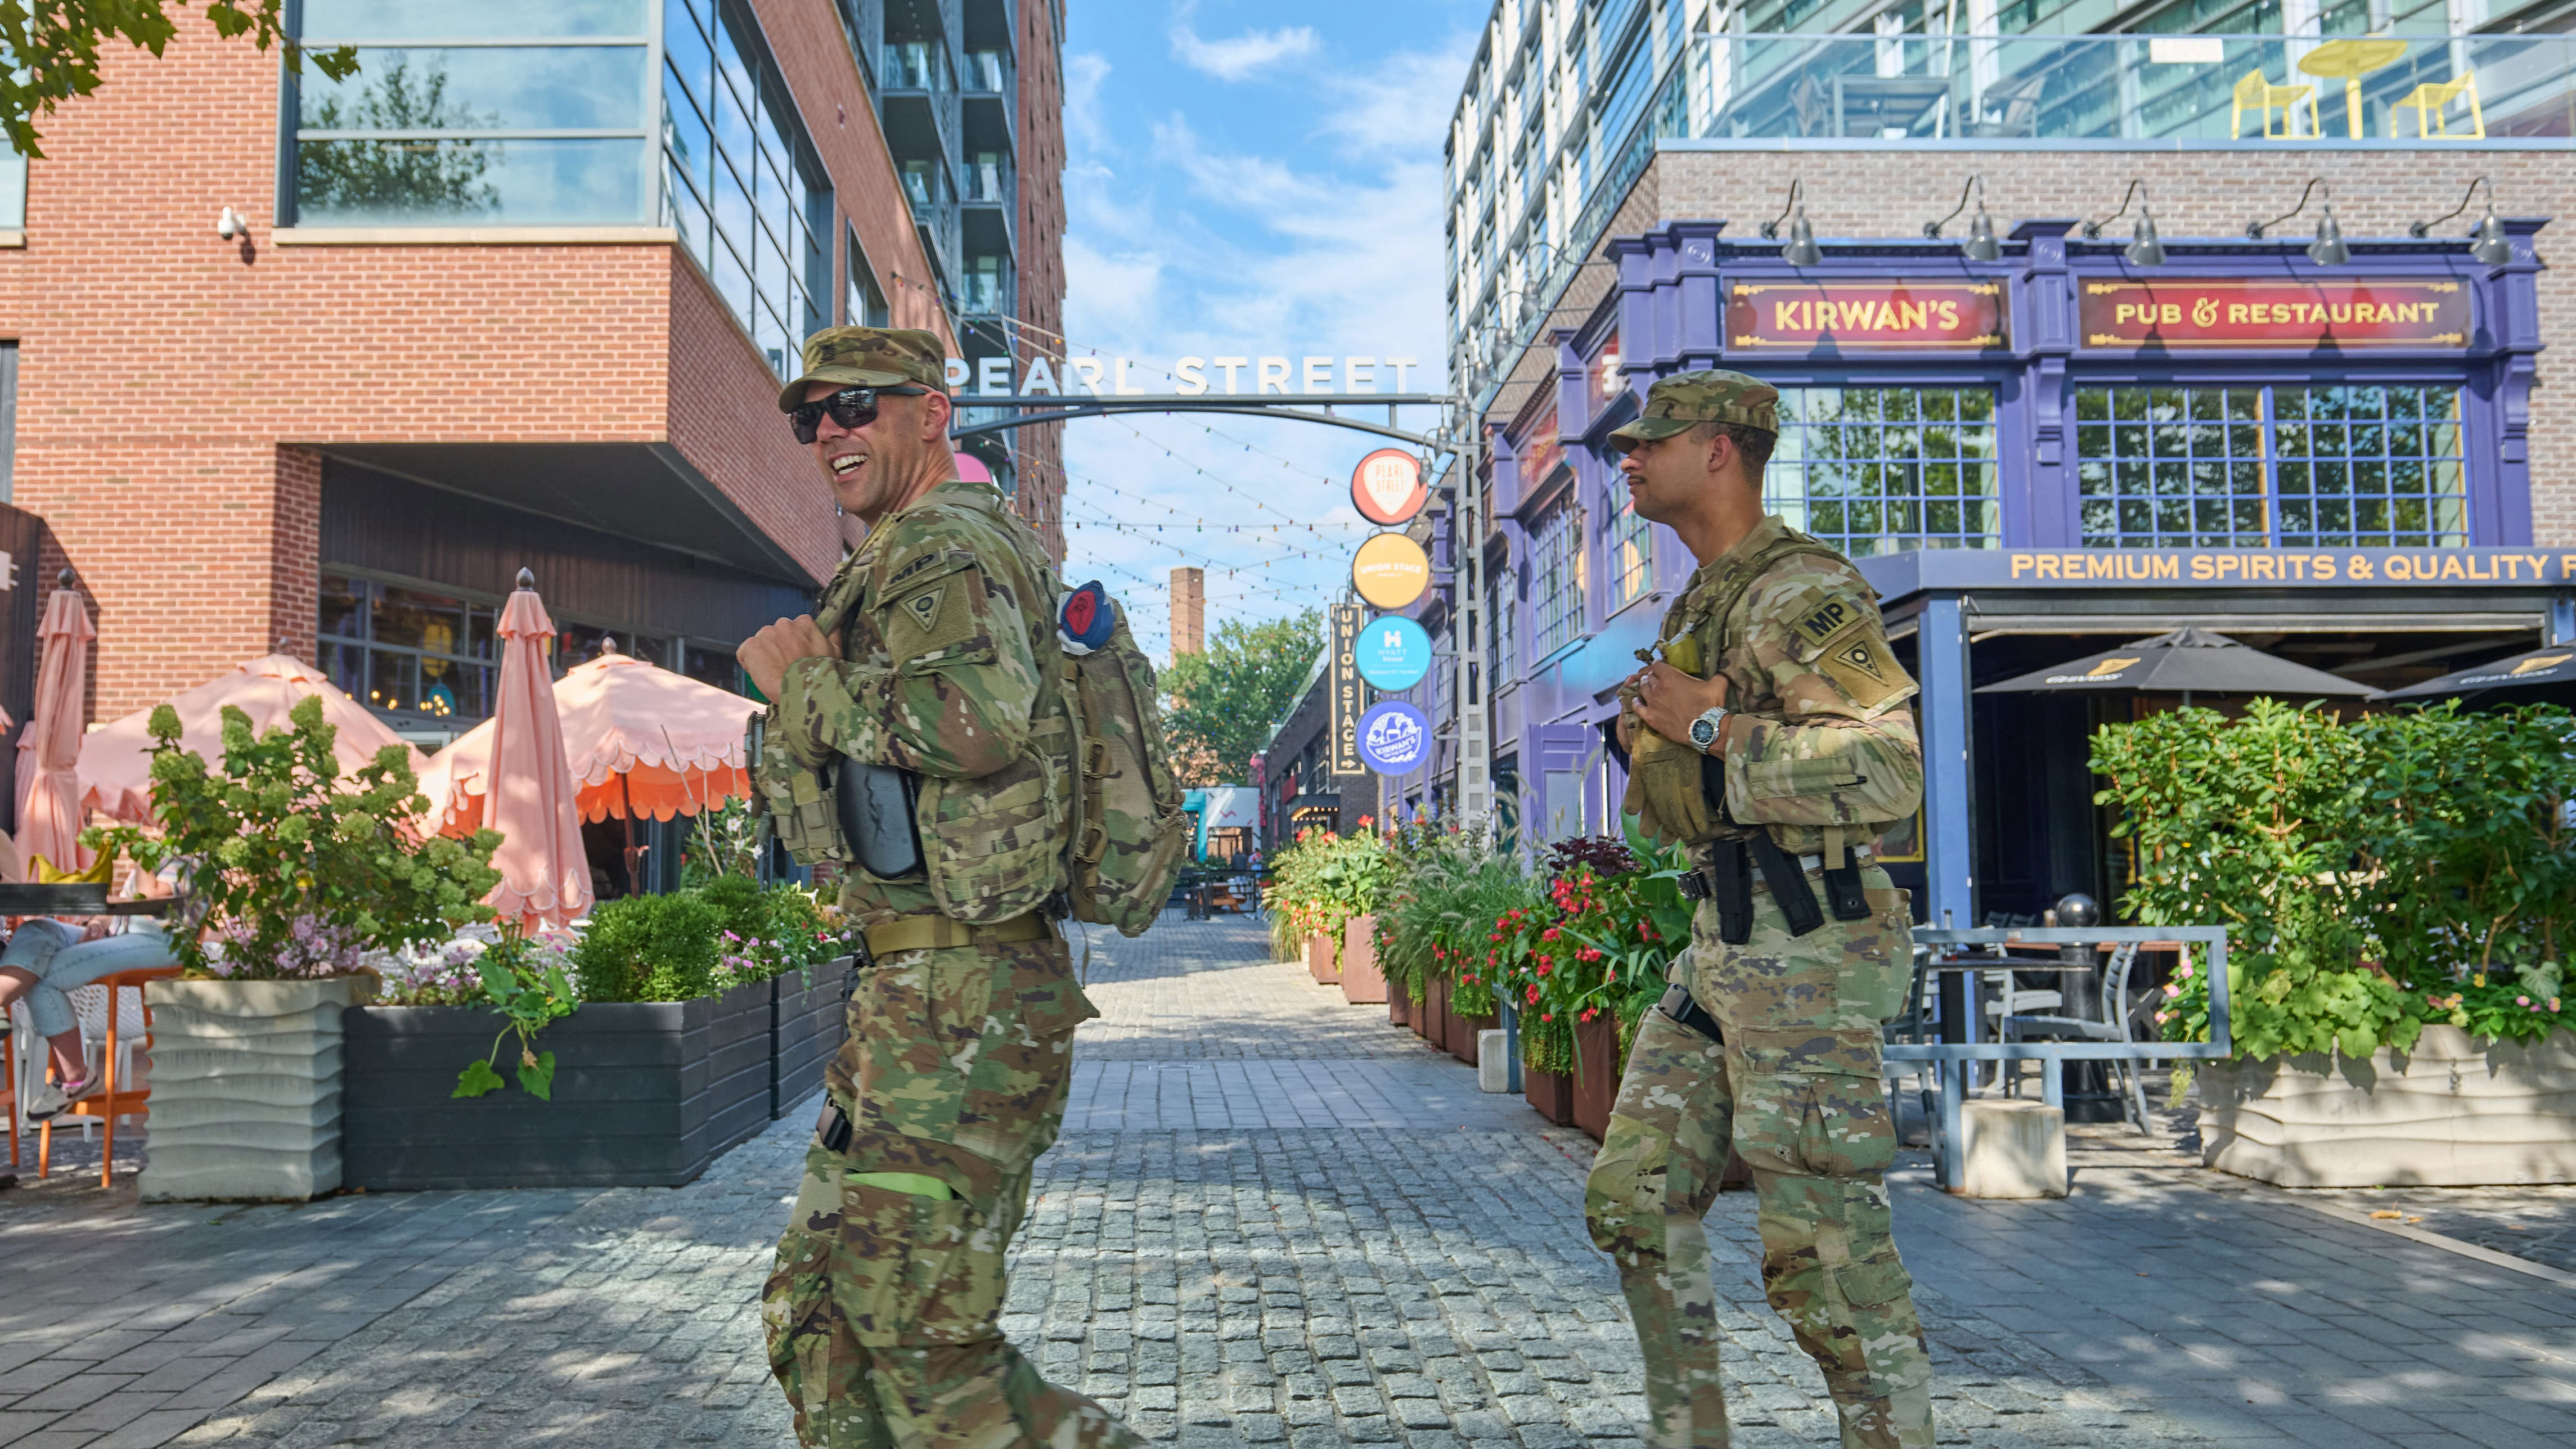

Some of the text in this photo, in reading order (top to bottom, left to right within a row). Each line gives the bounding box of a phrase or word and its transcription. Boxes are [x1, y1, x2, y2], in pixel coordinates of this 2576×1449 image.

[1775, 299, 1959, 331] KIRWAN'S
[2115, 297, 2439, 328] PUB & RESTAURANT
[945, 356, 1418, 396] PEARL STREET
[1376, 464, 1404, 478] PEARL
[1377, 480, 1404, 492] STREET
[890, 554, 934, 584] MP
[1361, 563, 1421, 574] UNION STAGE
[2011, 554, 2179, 579] PREMIUM
[2190, 554, 2337, 580] SPIRITS
[2346, 554, 2373, 580] &
[2384, 554, 2550, 581] QUALITY
[1804, 603, 1844, 637] MP
[1341, 610, 1355, 756] UNION STAGE
[1375, 735, 1416, 755] KIRWAN'S
